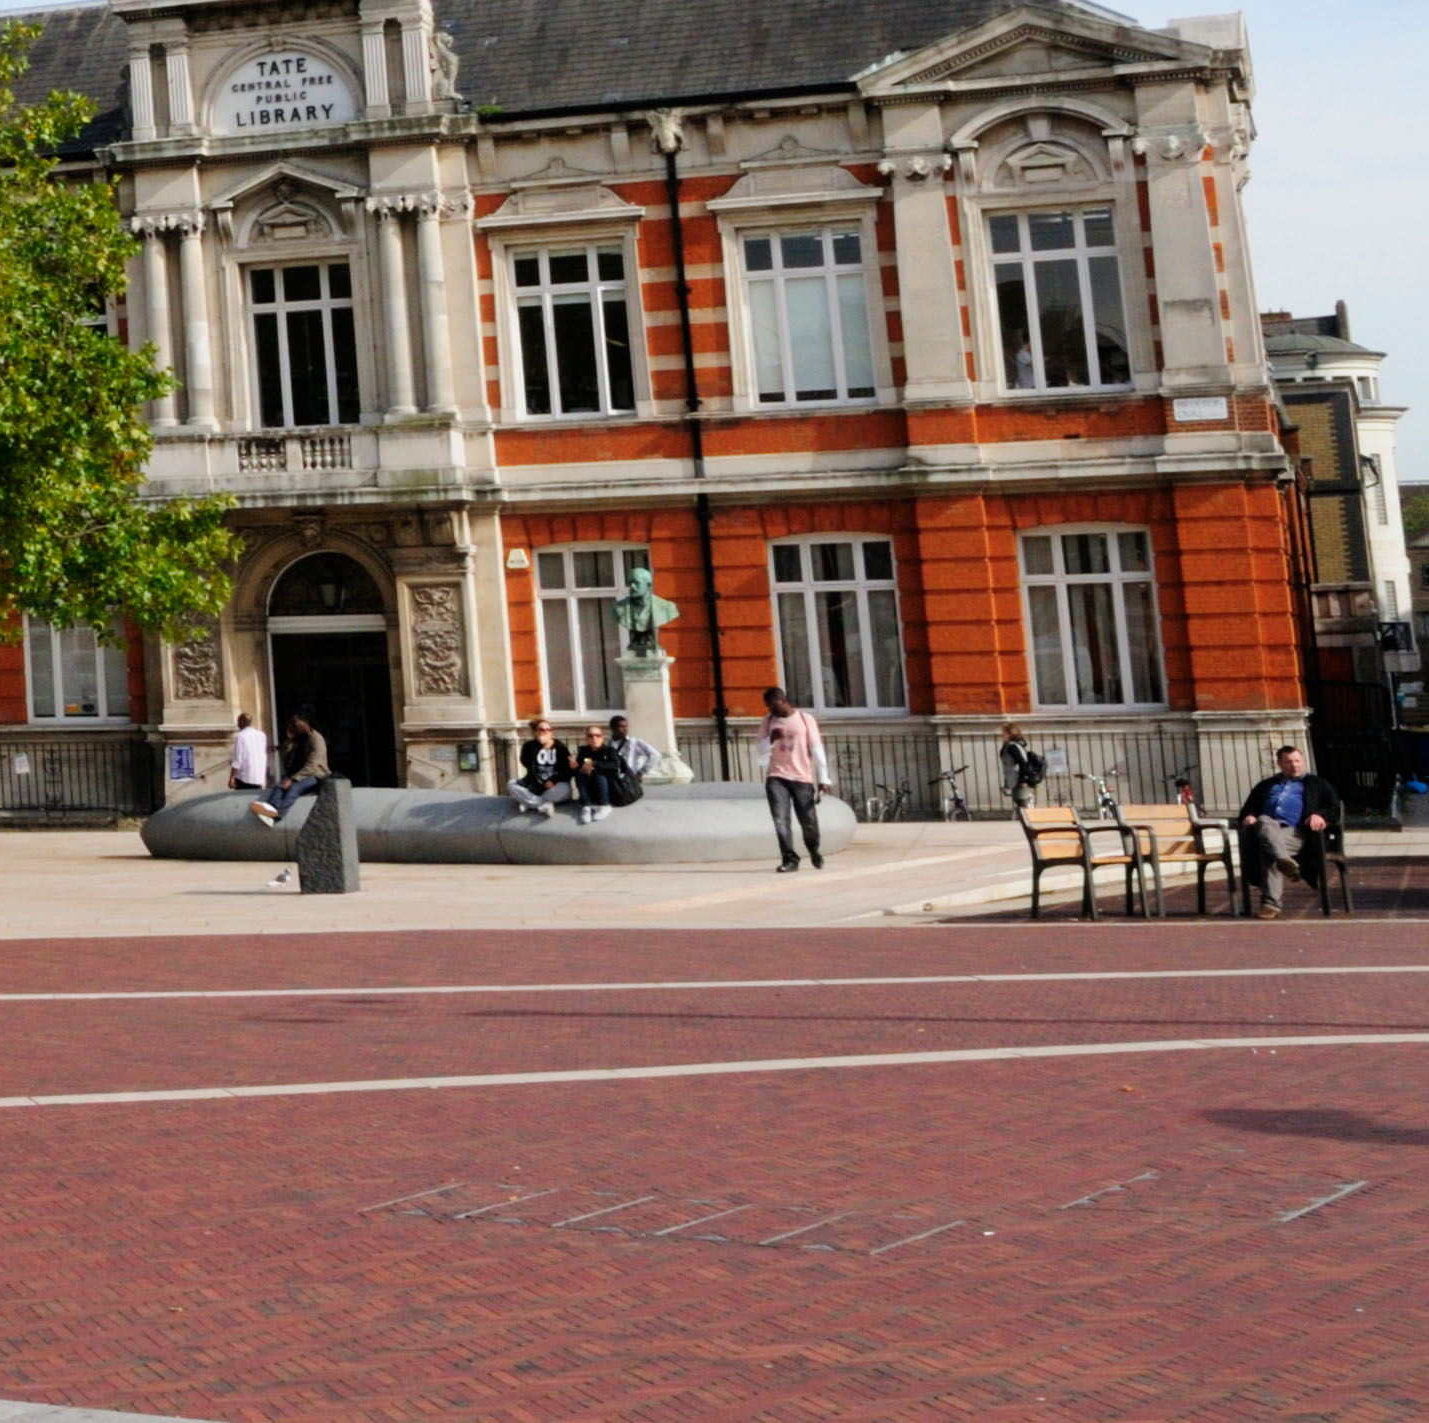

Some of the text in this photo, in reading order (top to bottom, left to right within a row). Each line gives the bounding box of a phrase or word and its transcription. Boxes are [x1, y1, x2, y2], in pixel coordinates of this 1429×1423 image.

[256, 57, 307, 76] TATE
[231, 75, 333, 93] CENTRAL FREE
[256, 91, 307, 104] PUBLIC
[236, 103, 334, 127] LIBRARY
